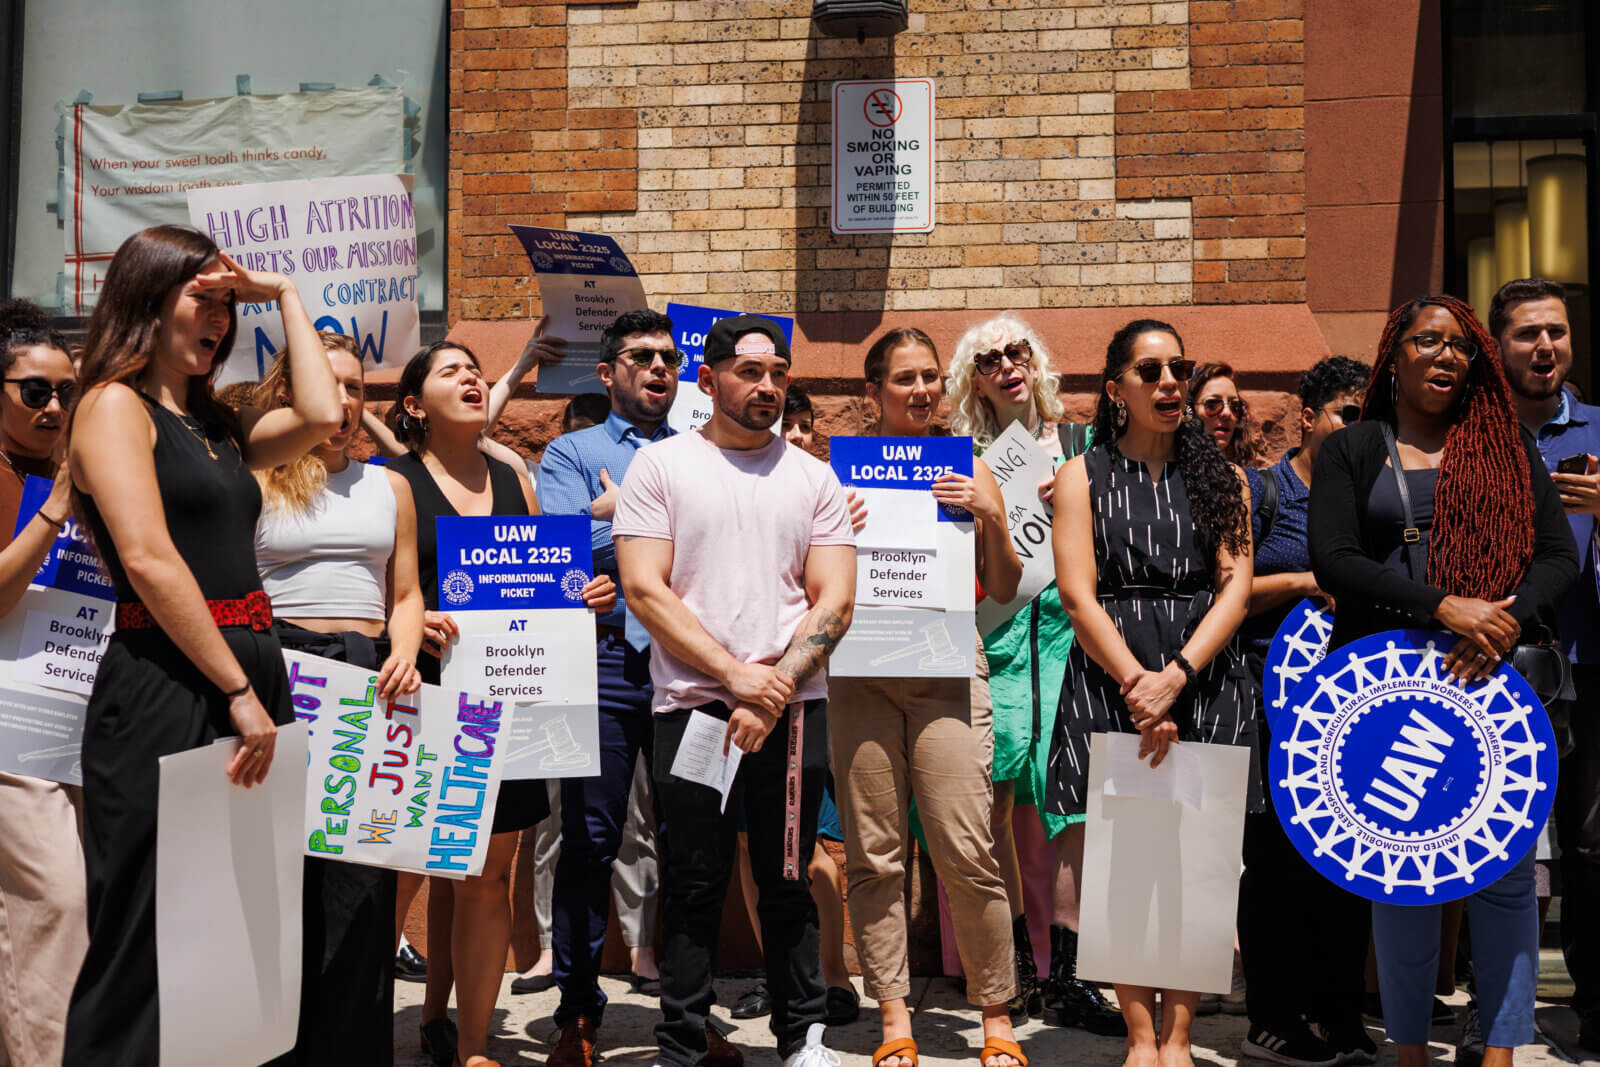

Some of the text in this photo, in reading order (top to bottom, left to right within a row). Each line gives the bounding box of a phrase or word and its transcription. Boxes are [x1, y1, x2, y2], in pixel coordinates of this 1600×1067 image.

[872, 129, 894, 140] NO
[846, 140, 920, 152] SMOKING
[89, 146, 327, 172] When your sweet tooth thinks candy,
[872, 152, 895, 164] OR
[854, 164, 912, 177] VAPING
[91, 184, 119, 198] Your
[125, 180, 174, 196] wisdom
[856, 181, 910, 191] PERMITTED
[847, 191, 920, 202] WITHIN 50 FEET
[853, 203, 914, 213] OF BUILDING
[206, 191, 415, 248] HIGH ATTRITION
[549, 231, 581, 242] UAW
[302, 245, 344, 272] OUR
[347, 236, 417, 268] MISSION
[534, 239, 611, 255] LOCAL 2325
[323, 275, 418, 307] CONTRACT
[575, 294, 616, 305] Brooklyn
[575, 307, 618, 317] Defender
[881, 445, 922, 461] UAW
[851, 465, 908, 480] LOCAL
[494, 525, 537, 542] UAW
[460, 547, 572, 565] LOCAL 2325
[871, 551, 926, 564] Brooklyn
[478, 574, 556, 584] INFORMATIONAL
[870, 568, 927, 581] Defender
[500, 588, 535, 598] PICKET
[872, 587, 923, 599] Services
[76, 606, 99, 621] AT
[508, 620, 528, 631] AT
[486, 645, 545, 658] Brooklyn
[485, 664, 547, 677] Defender
[489, 684, 543, 696] Services
[1369, 680, 1427, 696] IMPLEMENT
[1430, 683, 1474, 709] WORKERS
[1322, 693, 1369, 751] AGRICULTURAL
[1473, 709, 1487, 722] OF
[1484, 724, 1502, 766] AMERICA
[357, 696, 418, 844] WE JUST
[1320, 753, 1328, 775] AND
[1362, 708, 1455, 822] UAW
[403, 744, 438, 828] WANT
[426, 691, 503, 871] HEALTHCARE
[1321, 780, 1354, 828] AEROSPACE
[1423, 833, 1460, 851] UNITED
